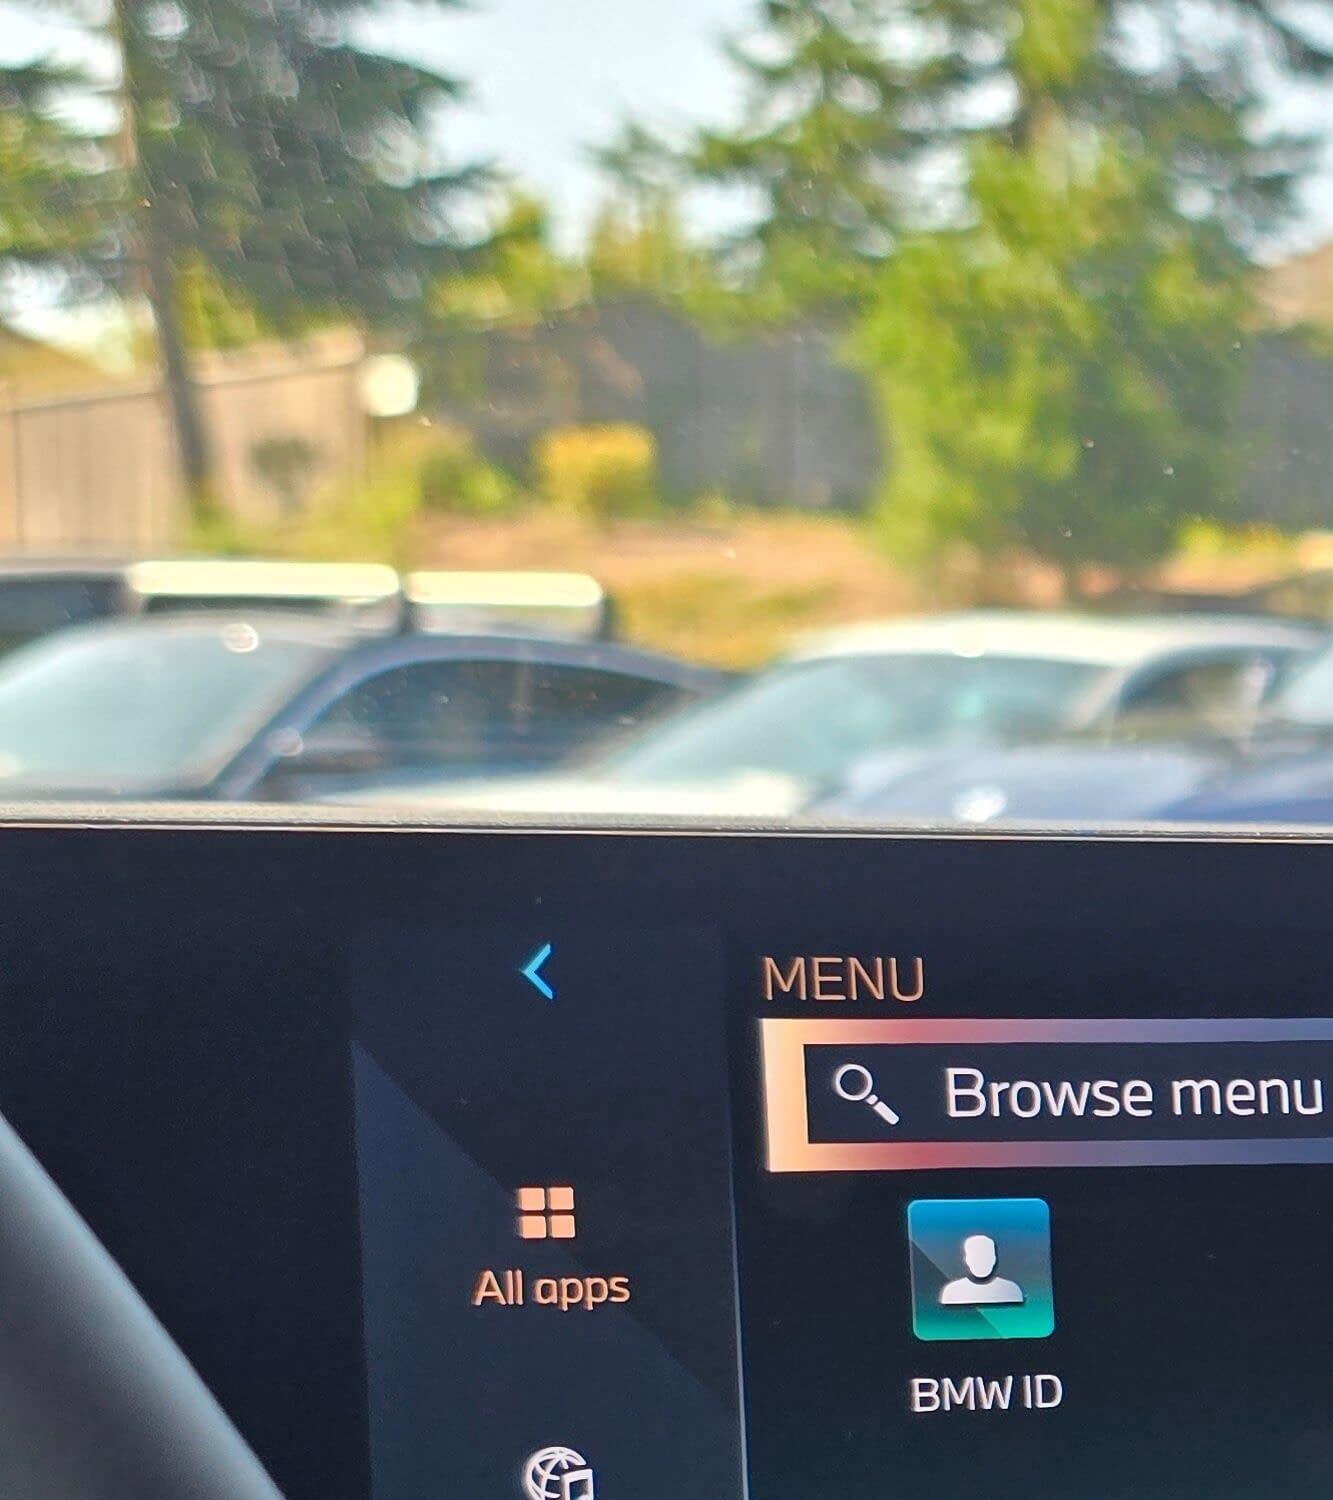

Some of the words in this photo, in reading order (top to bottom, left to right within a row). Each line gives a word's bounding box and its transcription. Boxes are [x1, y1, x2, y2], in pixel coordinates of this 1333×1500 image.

[764, 956, 924, 1002] MENU
[945, 1067, 1153, 1118] Browse
[1171, 1078, 1323, 1116] menu
[474, 1269, 524, 1306] All
[534, 1276, 630, 1312] apps
[911, 1375, 1013, 1413] BMW
[1024, 1374, 1063, 1409] ID
